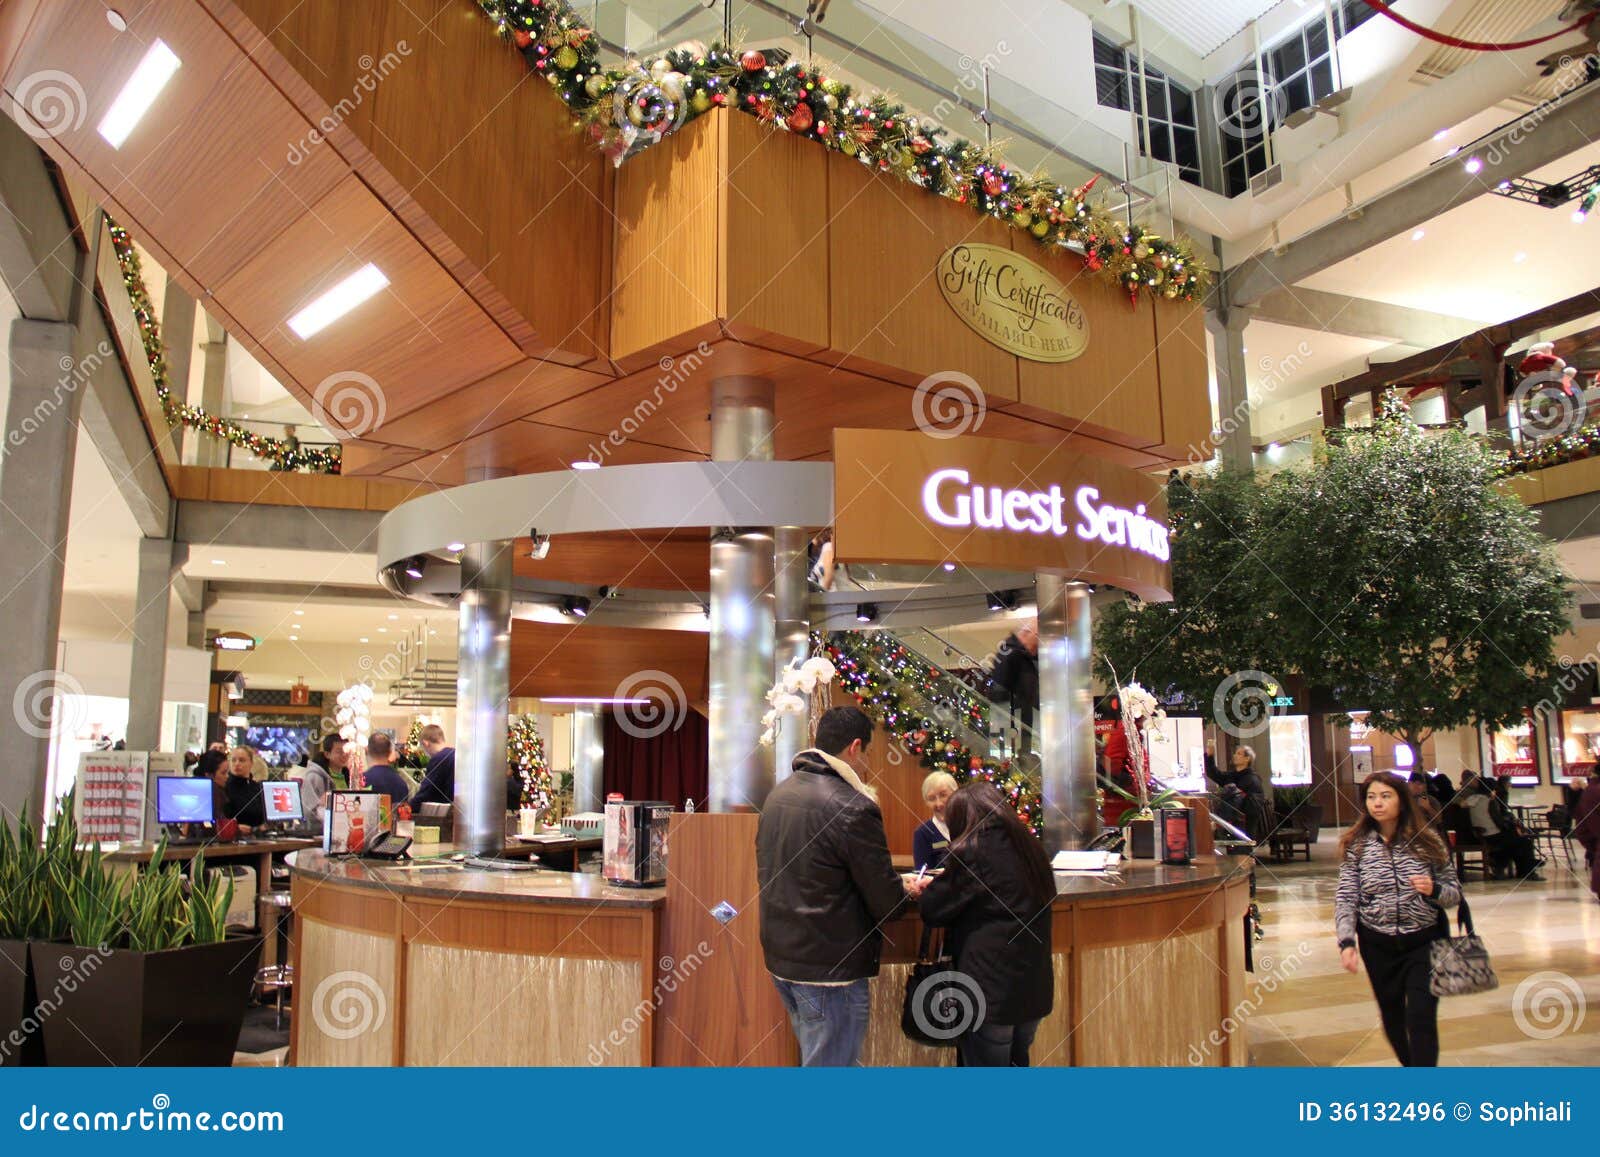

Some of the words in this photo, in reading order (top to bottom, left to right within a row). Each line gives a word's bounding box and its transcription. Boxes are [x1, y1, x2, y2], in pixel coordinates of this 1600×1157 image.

[944, 246, 995, 306] Gift
[996, 264, 1084, 331] Certificates
[960, 297, 1035, 348] AVAILABLE
[1041, 335, 1074, 351] HERE
[923, 468, 1067, 536] Guest
[1076, 486, 1170, 561] Services
